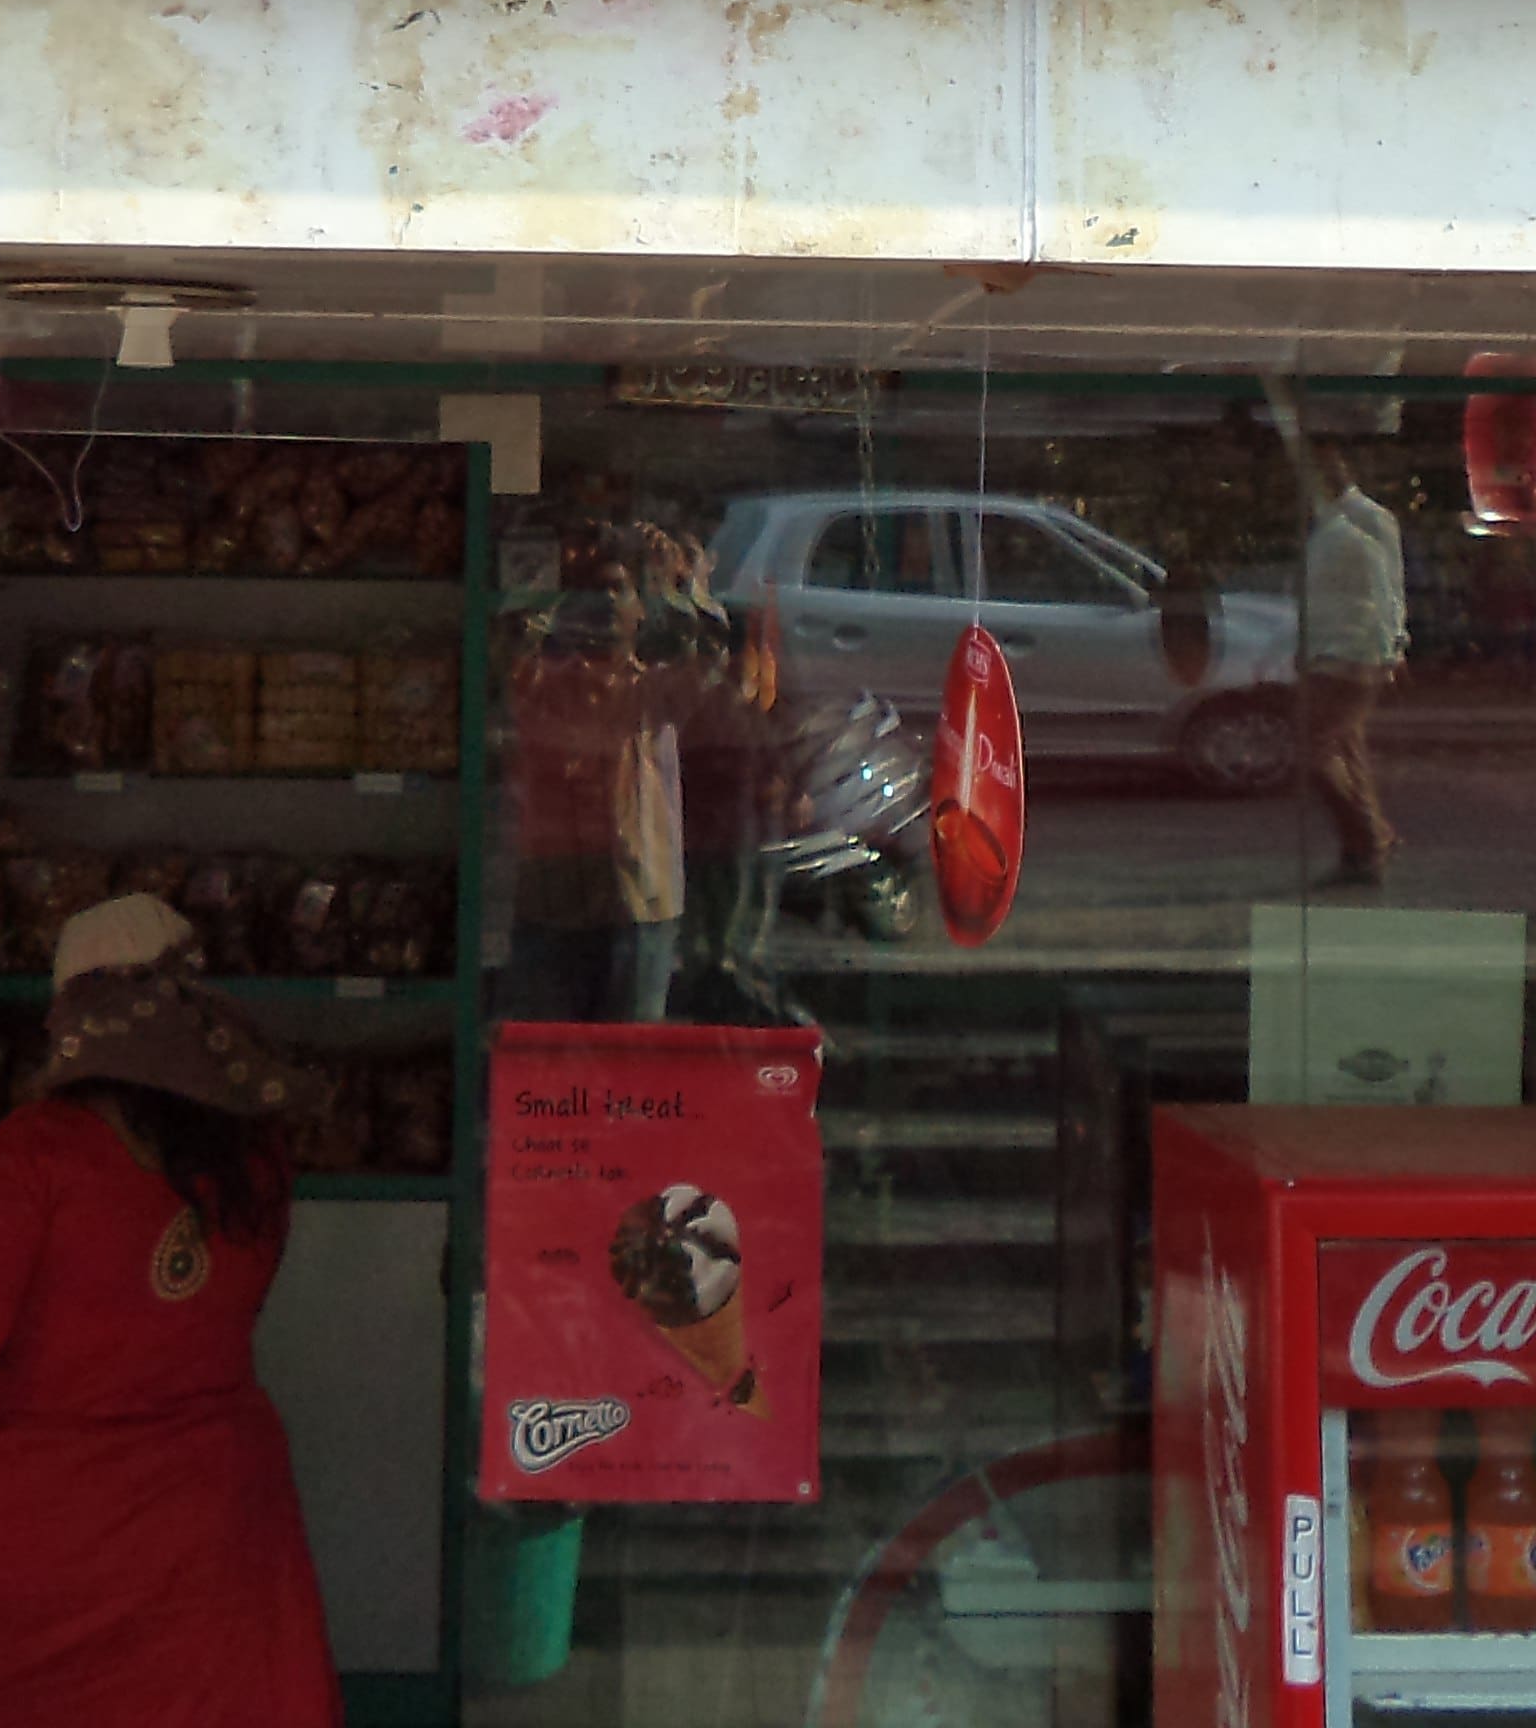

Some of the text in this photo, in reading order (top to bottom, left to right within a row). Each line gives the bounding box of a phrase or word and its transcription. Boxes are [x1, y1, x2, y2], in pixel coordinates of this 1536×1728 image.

[514, 1086, 590, 1119] Small
[509, 1398, 630, 1474] Cornetto
[1291, 1516, 1315, 1658] PULL
